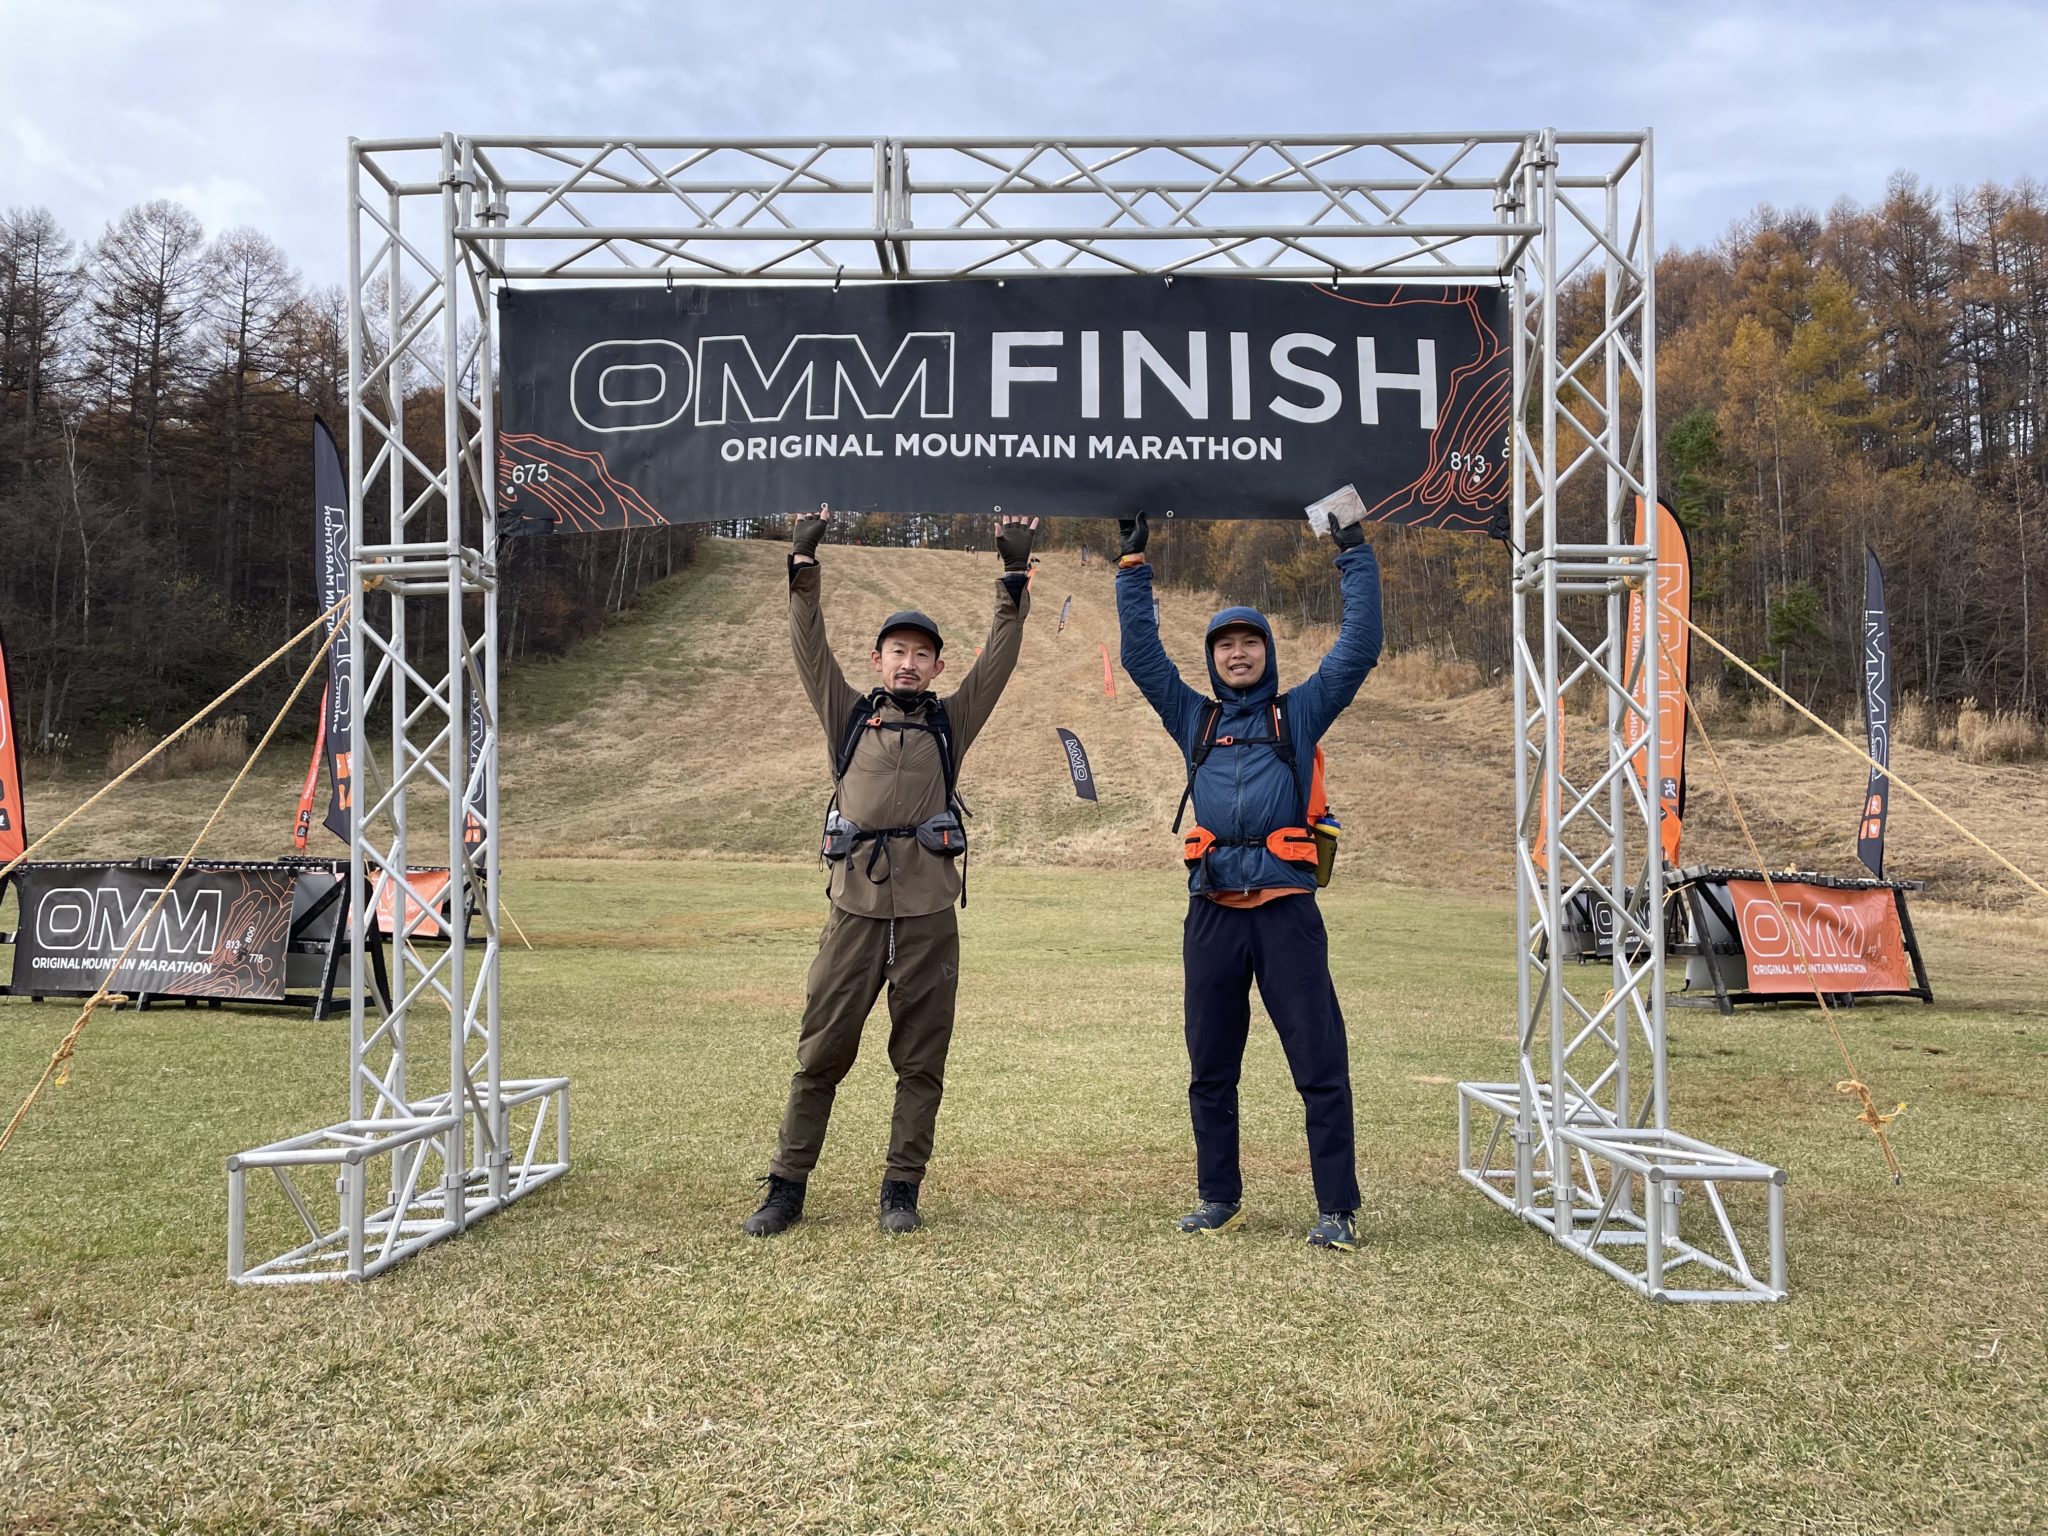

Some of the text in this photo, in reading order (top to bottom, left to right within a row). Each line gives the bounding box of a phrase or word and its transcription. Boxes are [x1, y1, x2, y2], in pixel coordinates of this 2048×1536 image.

[569, 329, 1440, 433] OMM FINISH
[720, 432, 1285, 462] ORIGINAL MOUNTAIN MARATHON
[1450, 451, 1486, 474] 813
[511, 463, 550, 485] 675
[35, 887, 223, 955] OMM
[1742, 898, 1866, 958] OMM
[225, 940, 241, 949] 813
[31, 956, 214, 975] ORIGINAL MOUNTIN MARATHON
[248, 953, 264, 964] 778
[1752, 964, 1793, 975] ORIGINAL
[1793, 963, 1834, 975] MONTAIN
